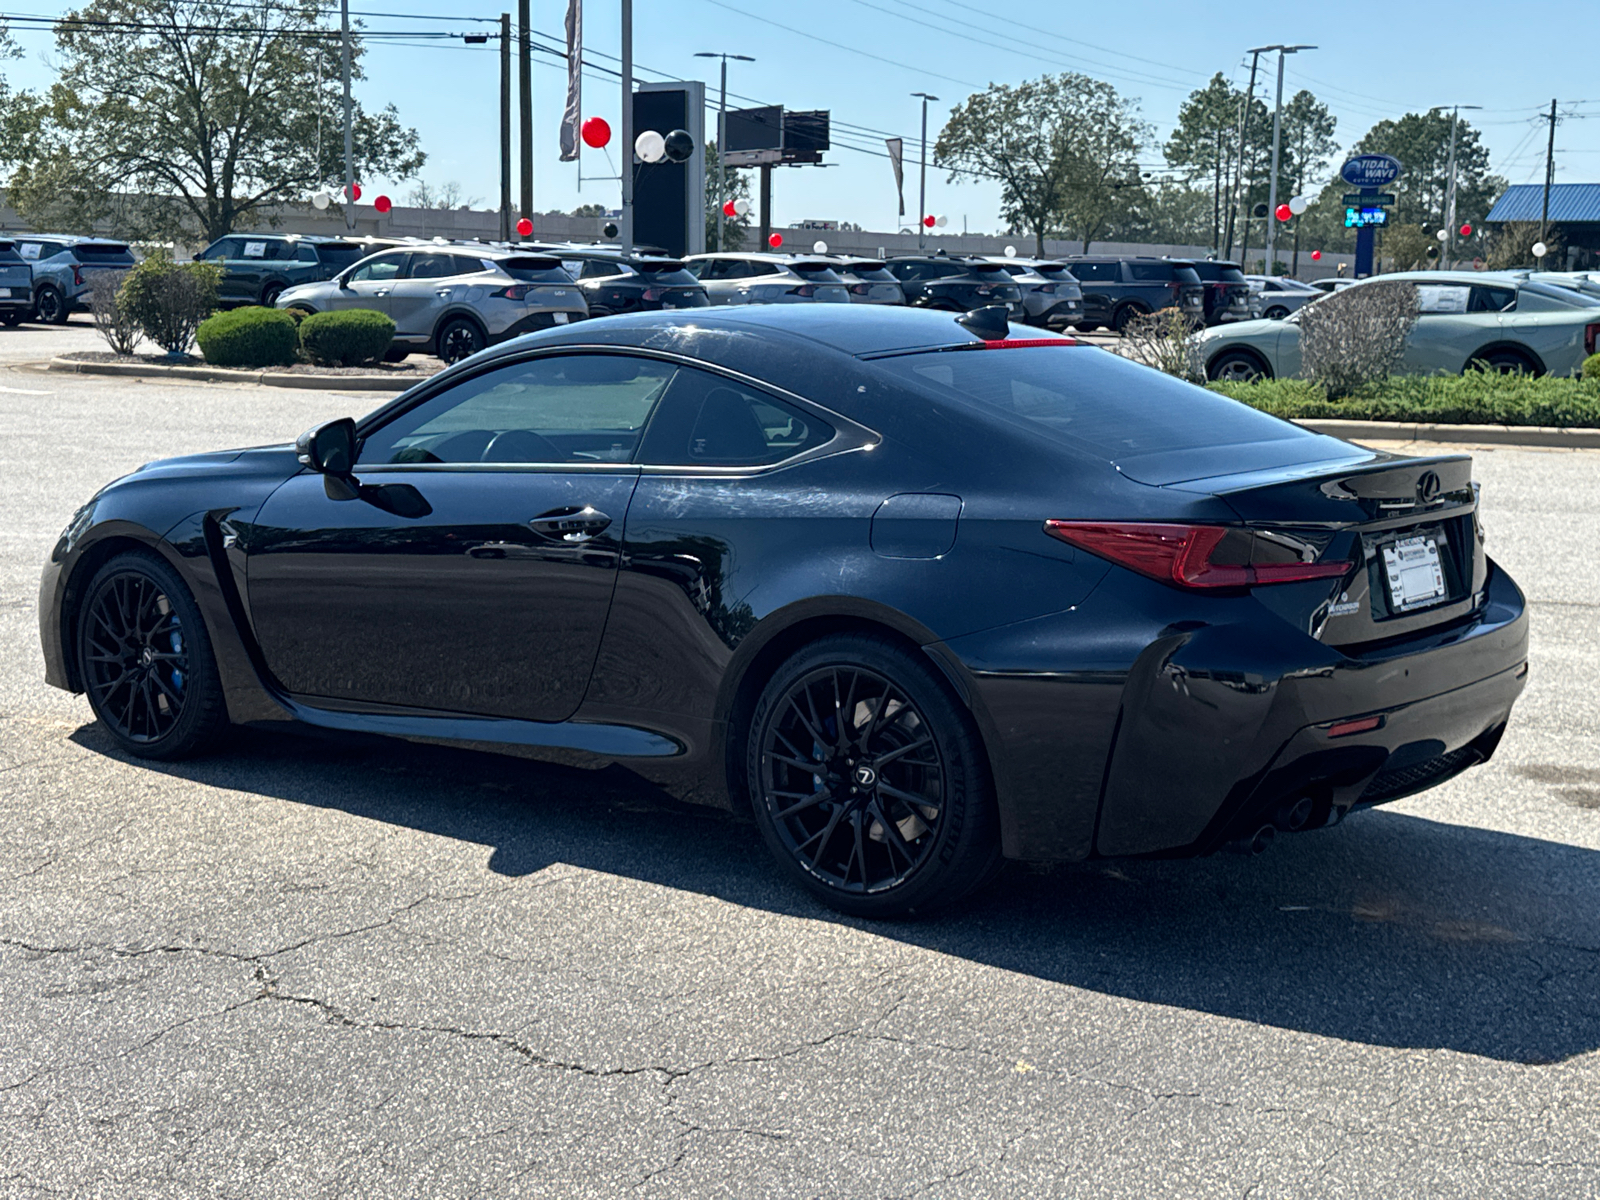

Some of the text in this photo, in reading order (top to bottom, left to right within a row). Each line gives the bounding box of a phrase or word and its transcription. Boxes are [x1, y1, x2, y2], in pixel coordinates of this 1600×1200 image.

[1361, 160, 1390, 169] TIDAL
[1365, 168, 1395, 178] WAVE
[941, 764, 965, 865] MICHELIN
